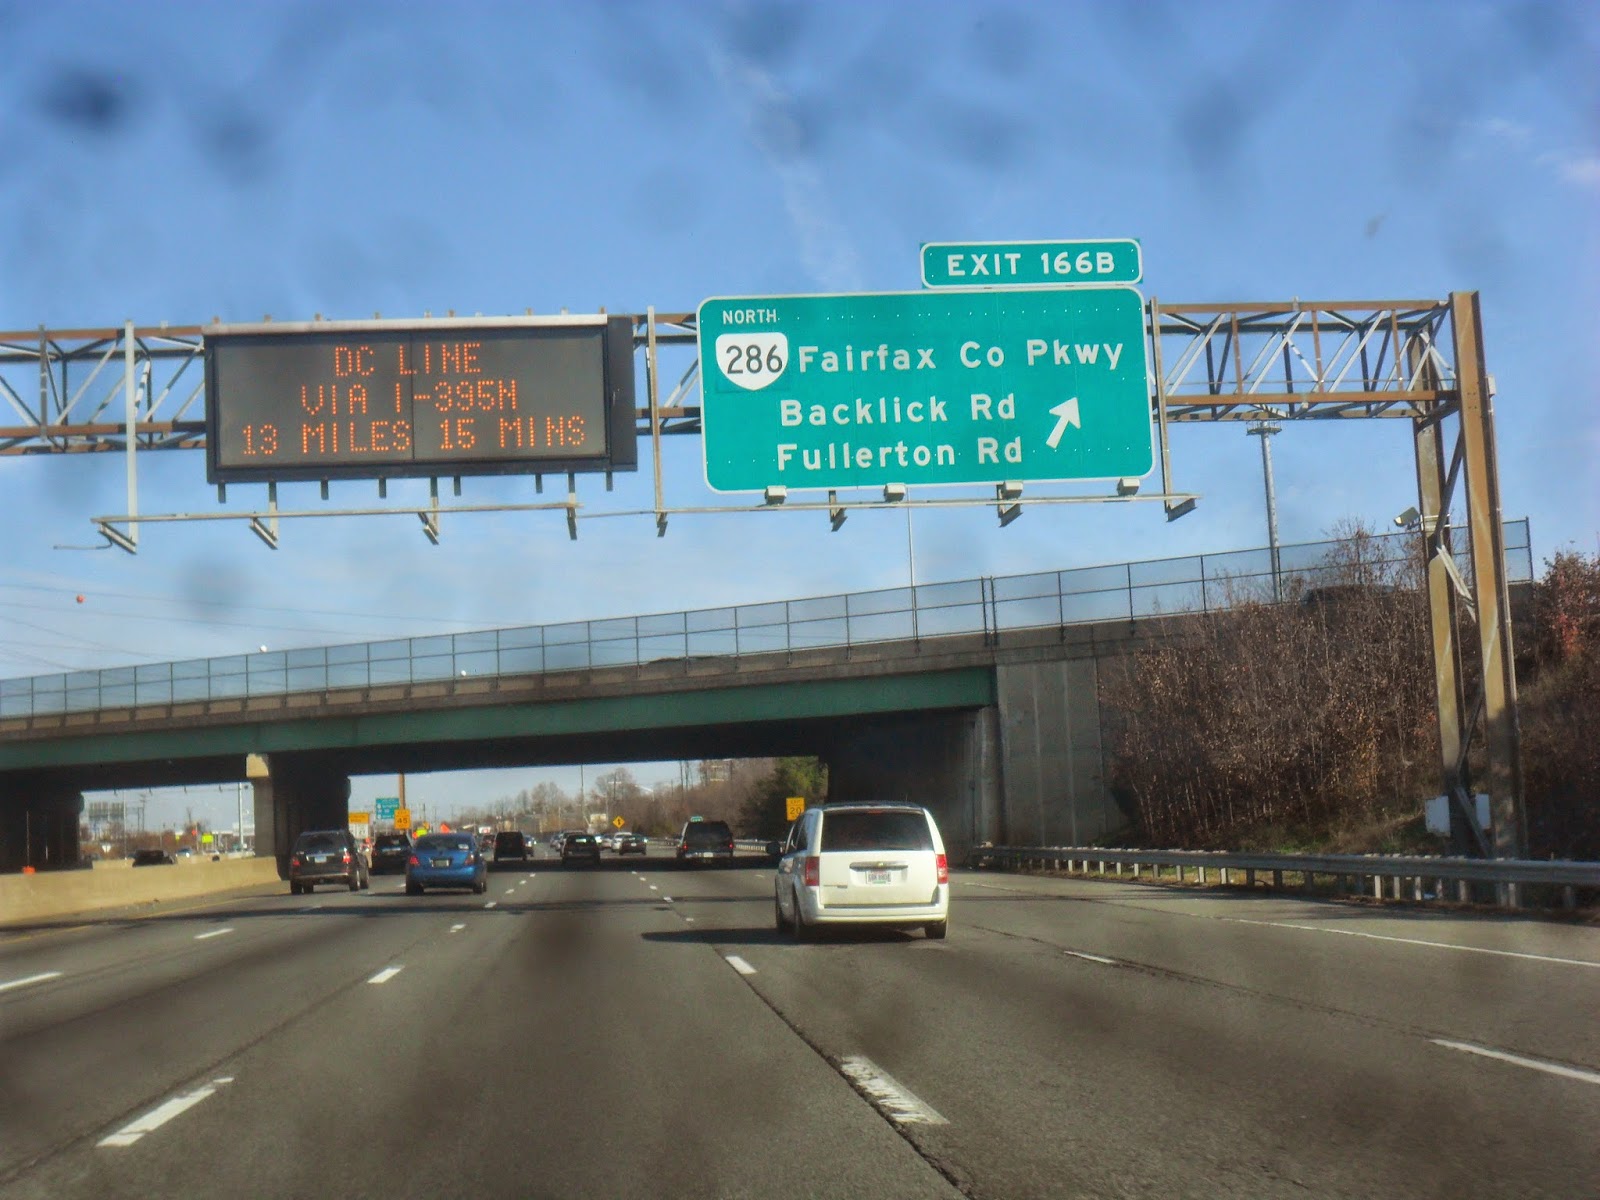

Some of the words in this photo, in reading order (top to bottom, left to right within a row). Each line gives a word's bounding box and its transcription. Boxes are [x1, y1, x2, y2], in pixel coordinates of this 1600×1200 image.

[947, 252, 1022, 276] EXIT
[1041, 251, 1116, 275] 166B
[722, 308, 777, 325] NORTH
[334, 345, 375, 378] DC
[399, 342, 482, 375] LINE
[726, 344, 783, 374] 286
[798, 344, 937, 373] Fairfax
[960, 340, 1005, 369] Co
[1027, 338, 1124, 371] Pkwy
[302, 383, 368, 415] VIA
[780, 395, 949, 427] Backlick
[970, 392, 1016, 421] Rd
[242, 424, 278, 455] 13
[302, 420, 412, 453] MILES
[439, 418, 476, 450] 15
[500, 416, 586, 448] MINS
[777, 443, 956, 471] Fullerton
[977, 436, 1023, 464] Rd
